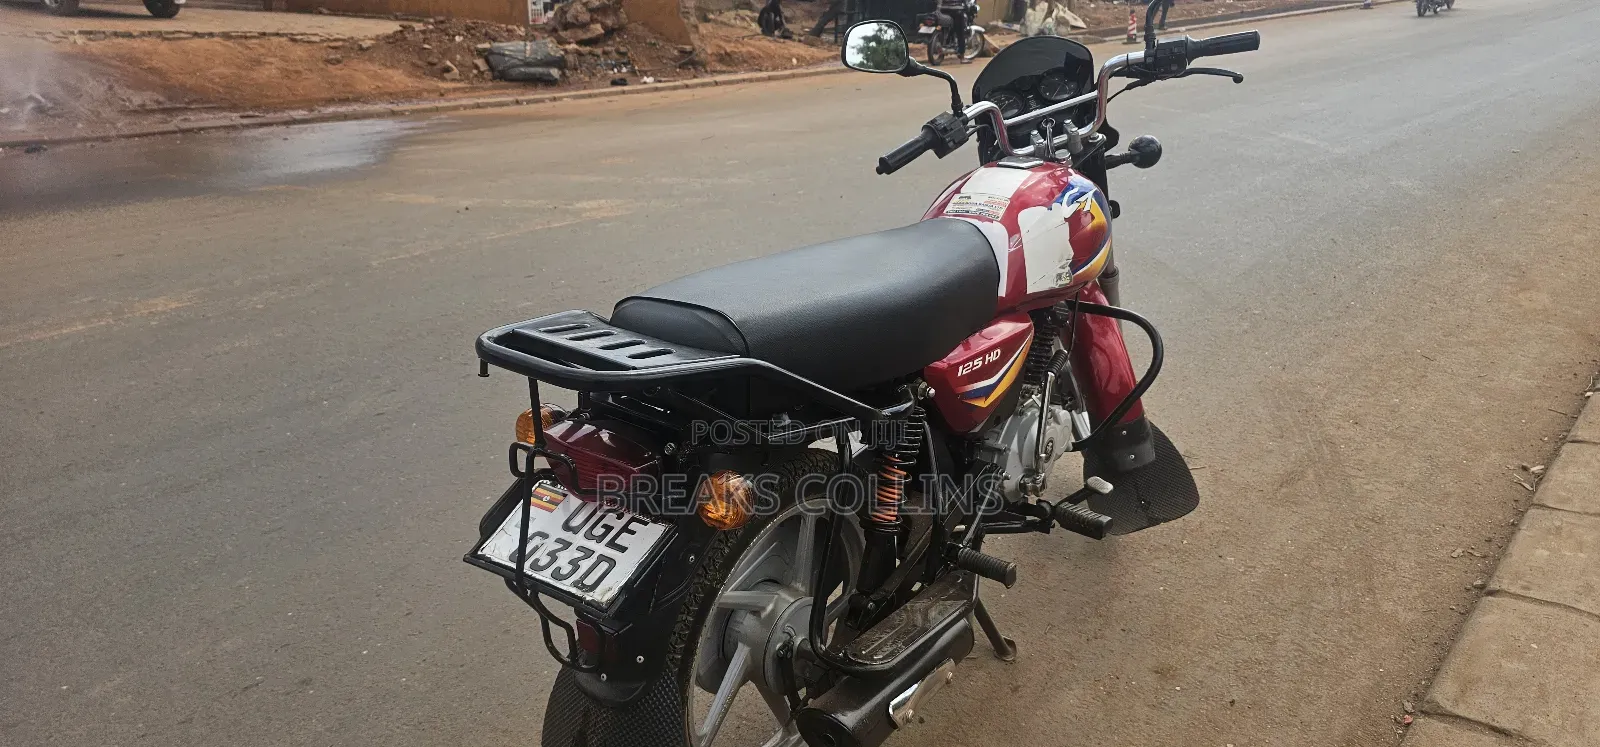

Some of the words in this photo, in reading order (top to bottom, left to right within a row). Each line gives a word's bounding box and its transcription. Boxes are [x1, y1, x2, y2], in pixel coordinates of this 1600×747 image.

[957, 357, 983, 377] 125
[984, 348, 1001, 365] HD
[562, 501, 650, 553] UGE
